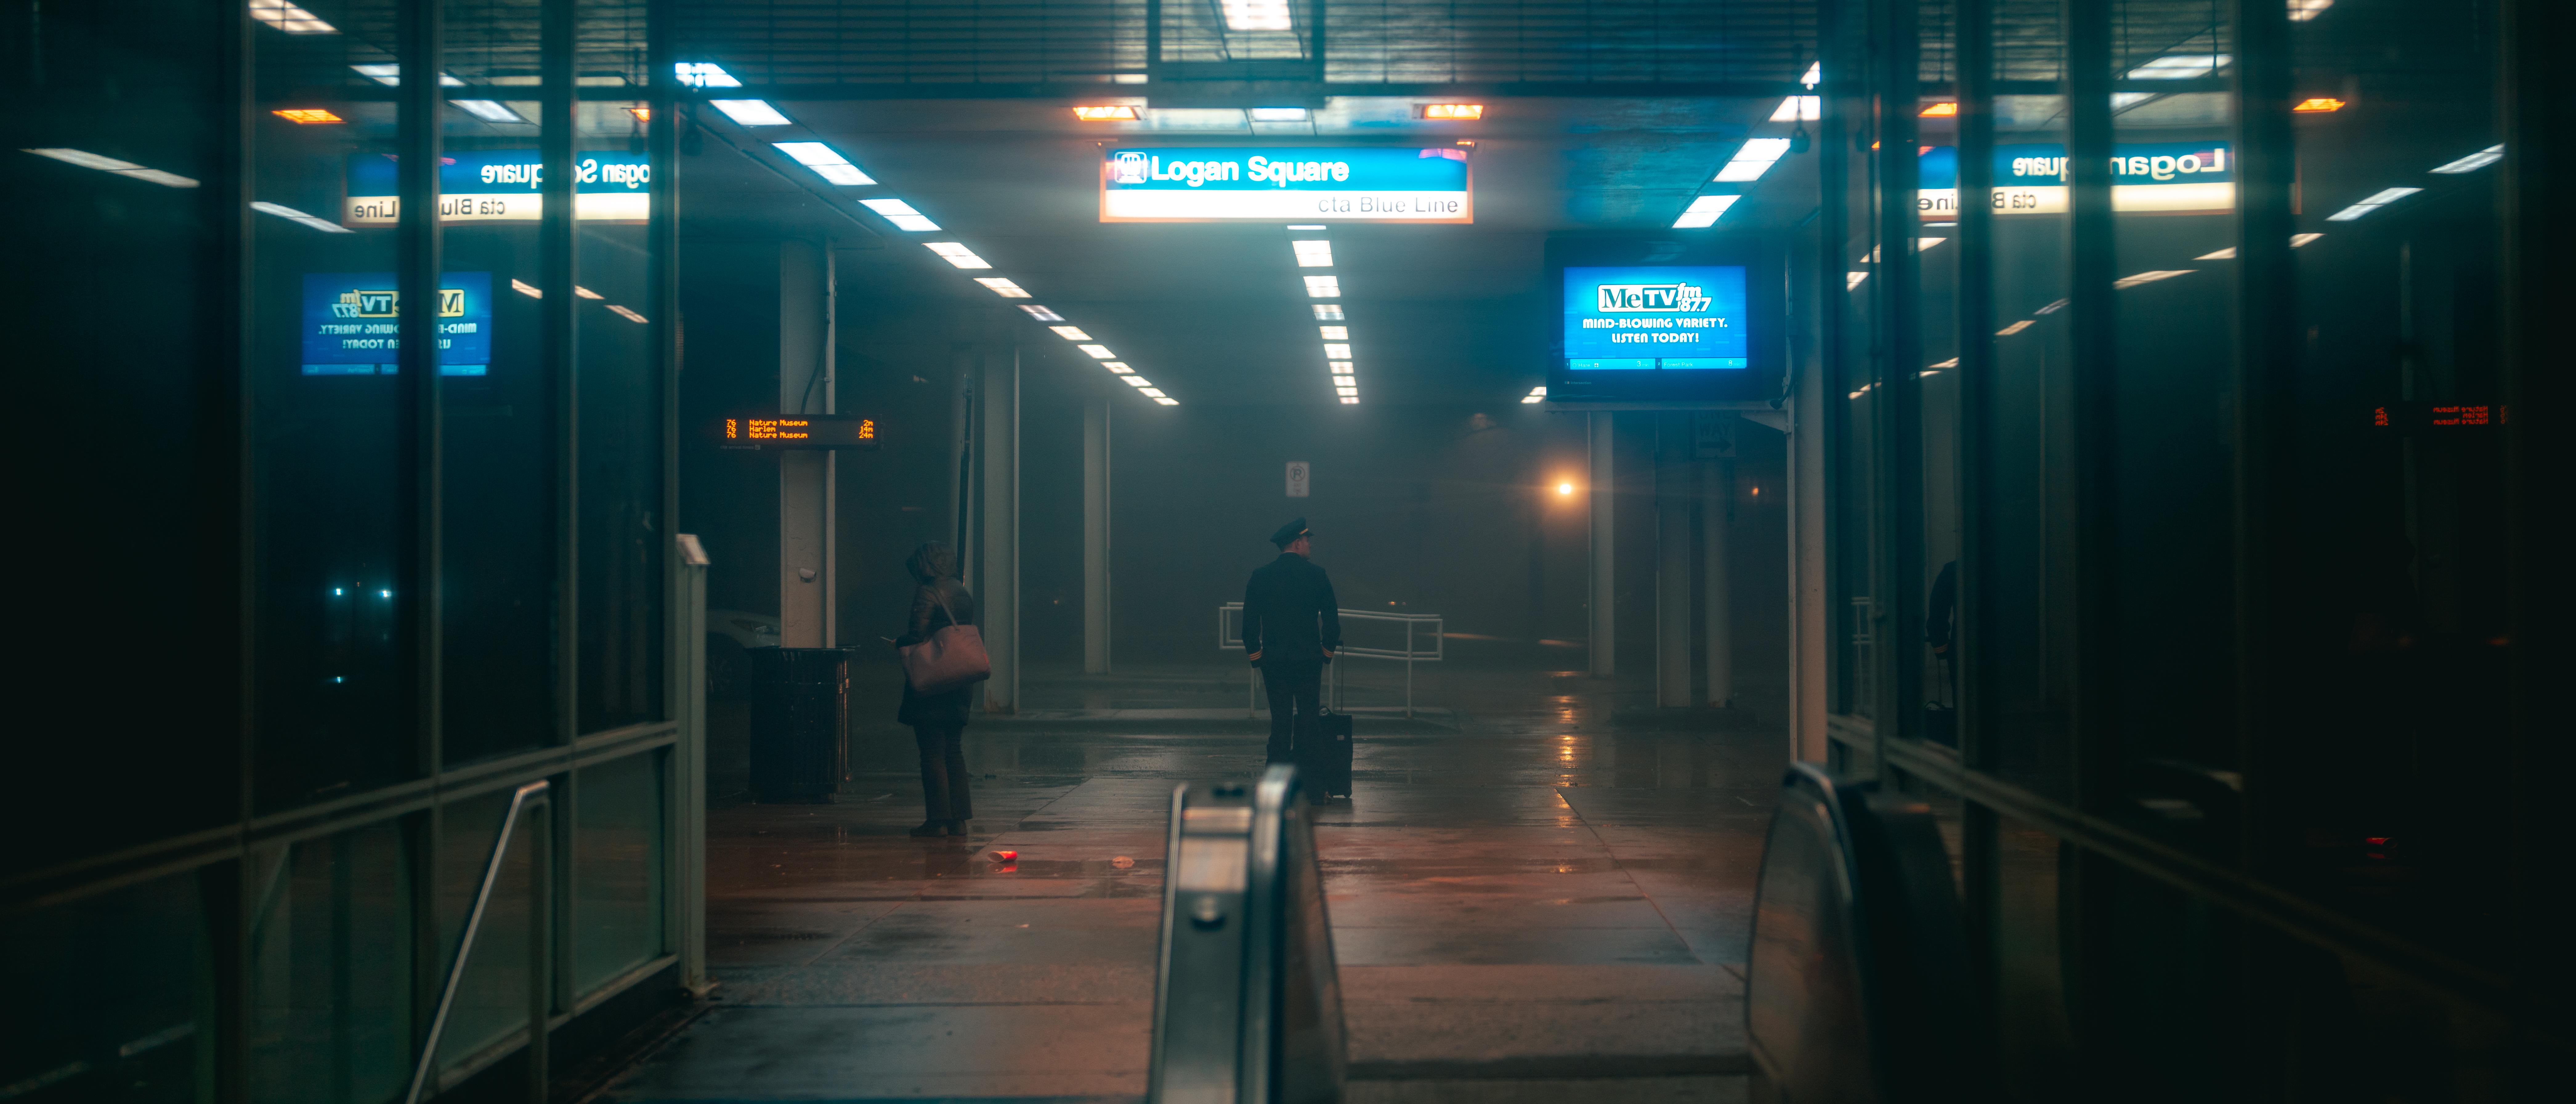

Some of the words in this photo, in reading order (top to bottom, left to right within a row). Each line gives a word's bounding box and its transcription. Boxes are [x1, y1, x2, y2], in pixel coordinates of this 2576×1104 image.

[1152, 156, 1239, 187] Logan
[1248, 156, 1349, 187] Square
[1318, 196, 1350, 212] cta
[1360, 196, 1406, 212] Blue
[1416, 196, 1458, 212] Line
[1676, 283, 1702, 301] fm
[1680, 297, 1712, 312] 87.7
[1583, 318, 1673, 329] MIND-BLOWING
[1676, 318, 1728, 328] VARIETY.
[1612, 333, 1648, 343] LISTEN
[1651, 333, 1699, 343] TODAY!
[1699, 423, 1732, 436] WAY
